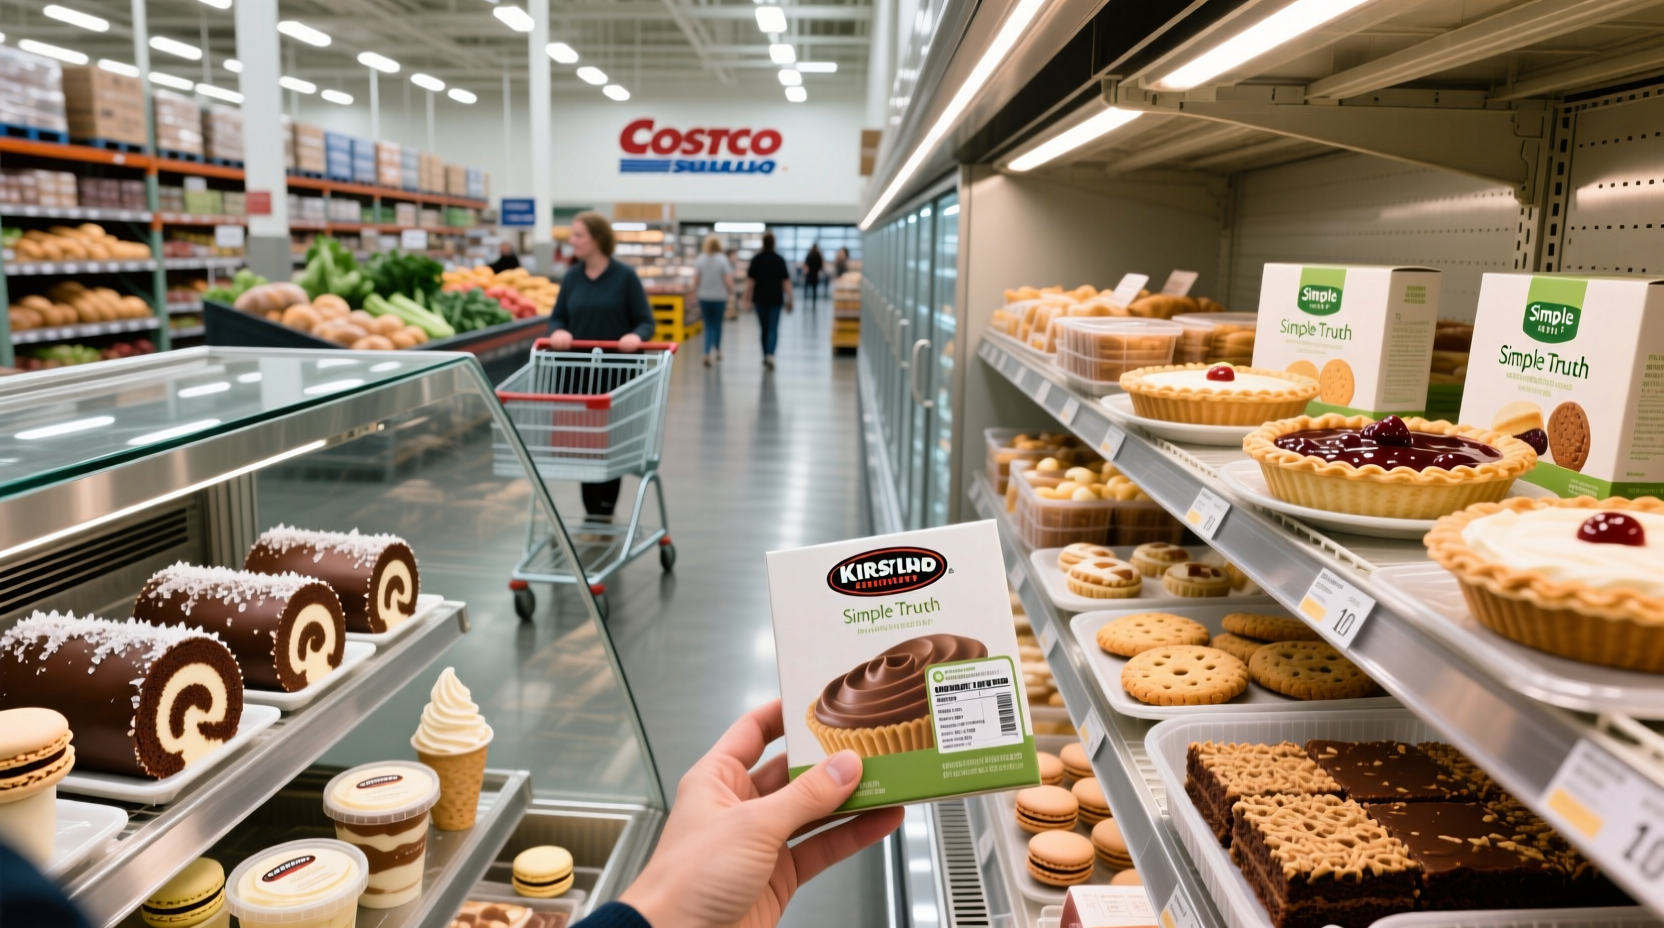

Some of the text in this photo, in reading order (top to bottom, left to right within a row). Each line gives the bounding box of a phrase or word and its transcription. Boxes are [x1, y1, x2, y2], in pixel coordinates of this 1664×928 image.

[1529, 304, 1574, 326] Simple
[1319, 322, 1352, 341] Truth
[1498, 344, 1589, 379] Simple Truth
[843, 597, 940, 624] Simple Truth
